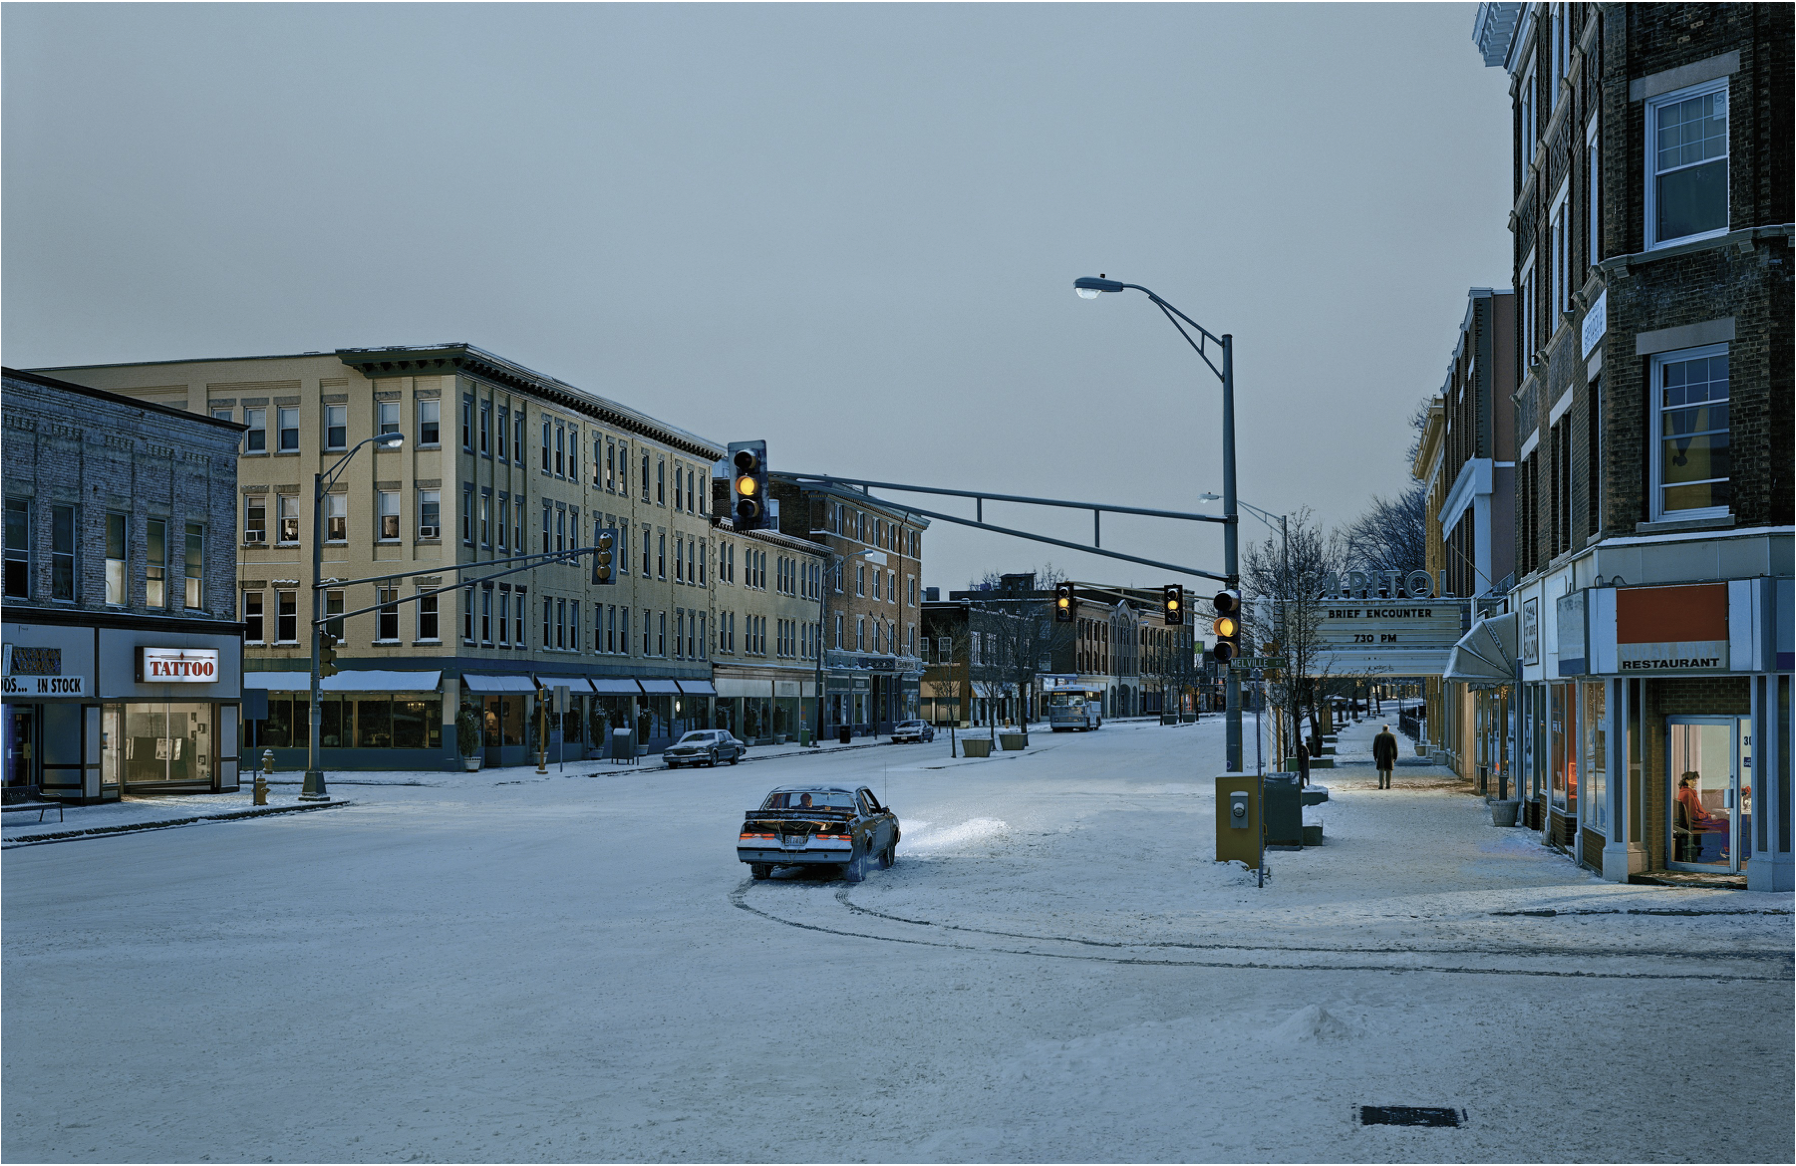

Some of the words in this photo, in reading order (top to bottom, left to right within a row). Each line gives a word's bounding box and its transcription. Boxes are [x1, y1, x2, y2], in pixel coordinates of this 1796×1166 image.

[1328, 609, 1361, 618] BRIEF
[1366, 608, 1432, 618] ENCOUNTER
[1353, 634, 1375, 643] 730
[1380, 634, 1397, 643] PM
[1230, 658, 1269, 668] MELVILLE
[1622, 657, 1720, 670] RESTAURANT
[149, 661, 214, 677] TATTOO
[1, 677, 28, 693] OS...
[37, 678, 48, 693] IN
[51, 678, 81, 693] STOCK
